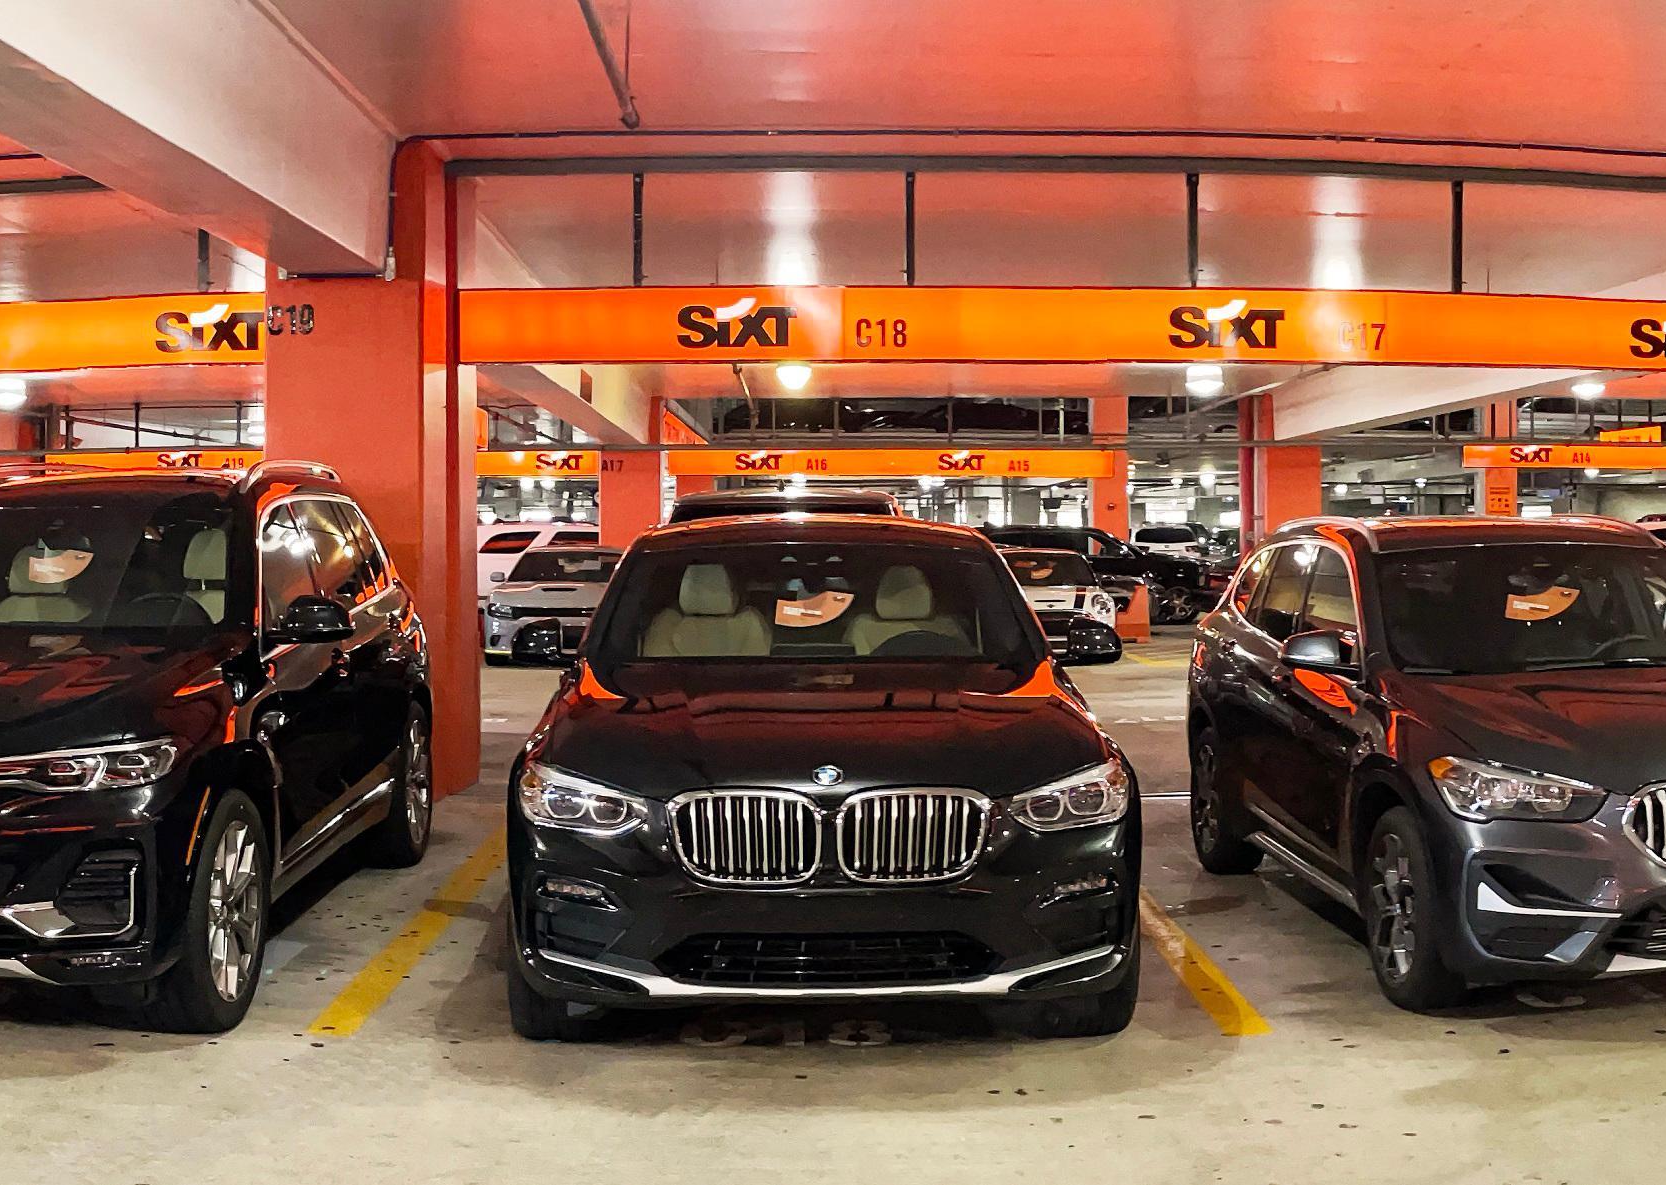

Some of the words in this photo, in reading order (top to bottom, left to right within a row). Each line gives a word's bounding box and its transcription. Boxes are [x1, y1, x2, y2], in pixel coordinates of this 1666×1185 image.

[268, 304, 315, 336] C19
[856, 318, 908, 348] C18
[1337, 321, 1386, 351] C17
[601, 459, 623, 472] A17
[806, 458, 828, 471] A16
[1008, 459, 1030, 472] A15
[1572, 453, 1590, 464] A14
